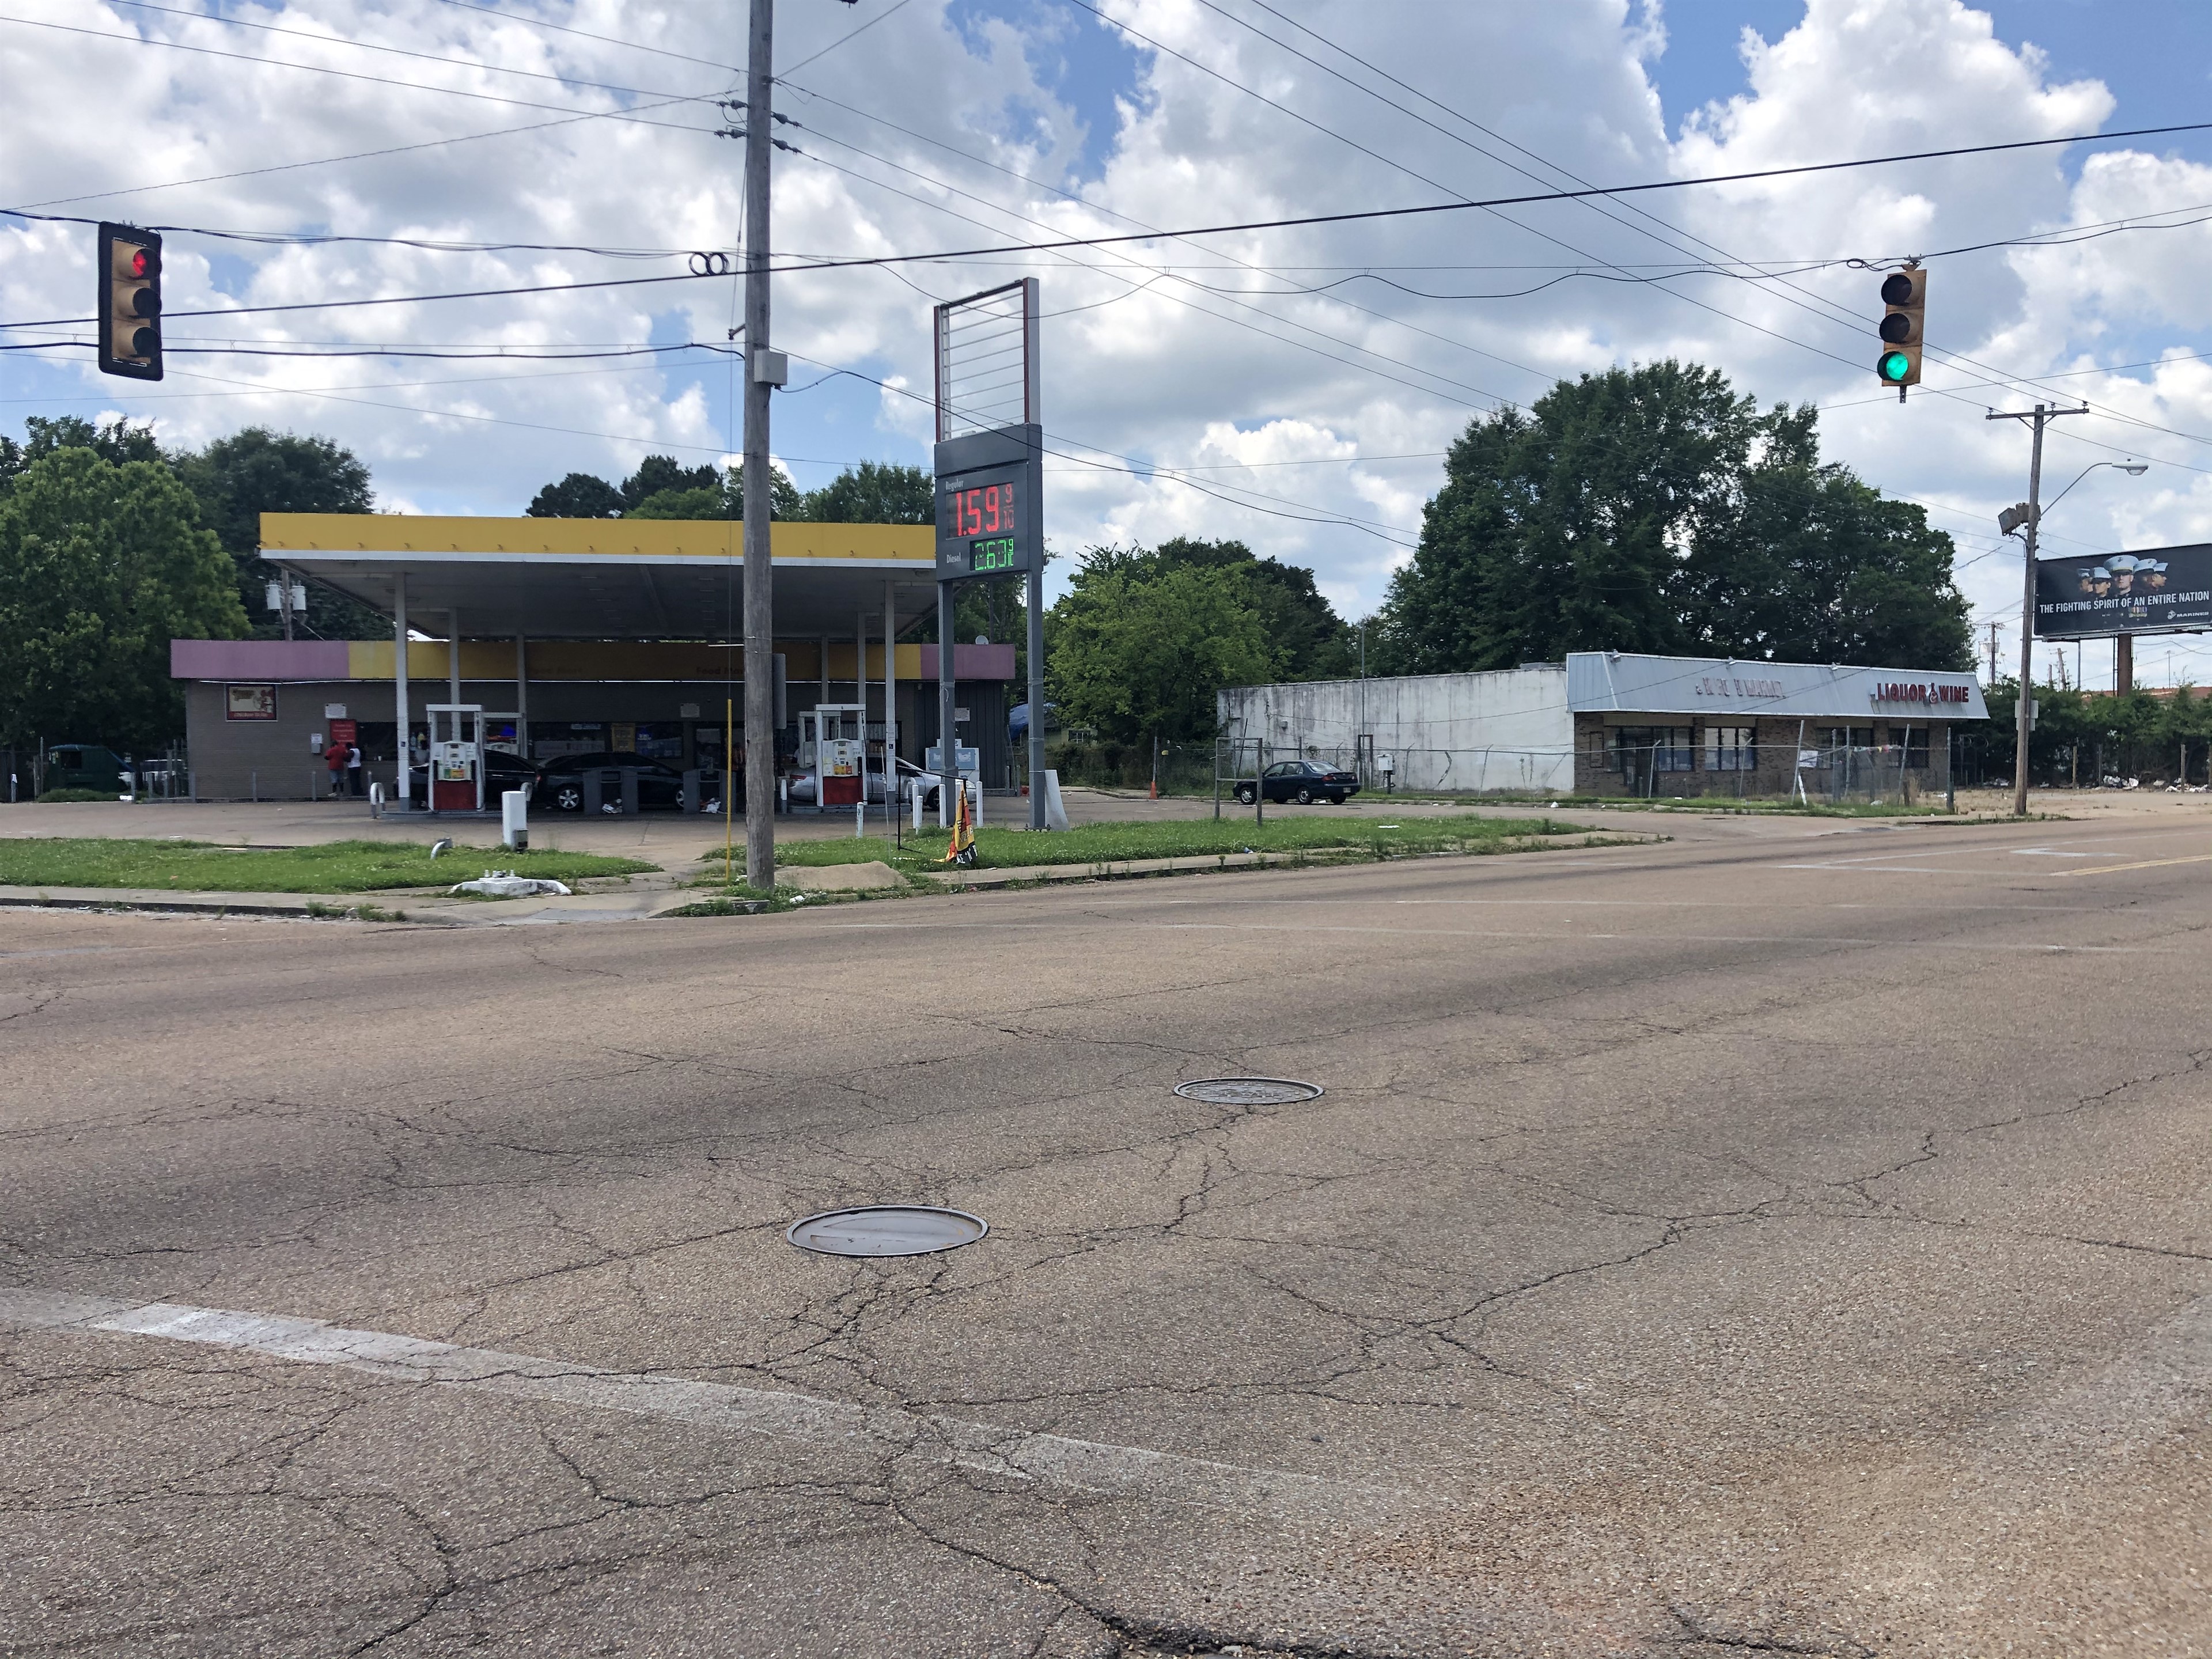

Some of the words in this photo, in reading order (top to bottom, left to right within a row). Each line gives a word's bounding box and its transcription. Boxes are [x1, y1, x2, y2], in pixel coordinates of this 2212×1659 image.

[945, 478, 964, 492] Regular
[956, 486, 999, 536] 1.59
[946, 552, 961, 563] Diesel
[2040, 604, 2054, 614] THE
[2056, 601, 2092, 613] FIGHTING
[2093, 598, 2119, 609] SPIRIT
[2121, 597, 2132, 608] OF
[2134, 596, 2145, 607] AN
[2147, 593, 2176, 605] ENTIRE
[2179, 590, 2210, 603] NATION
[724, 666, 743, 675] Mar
[1877, 682, 1926, 702] LIQUOR
[1938, 685, 1969, 703] WINE
